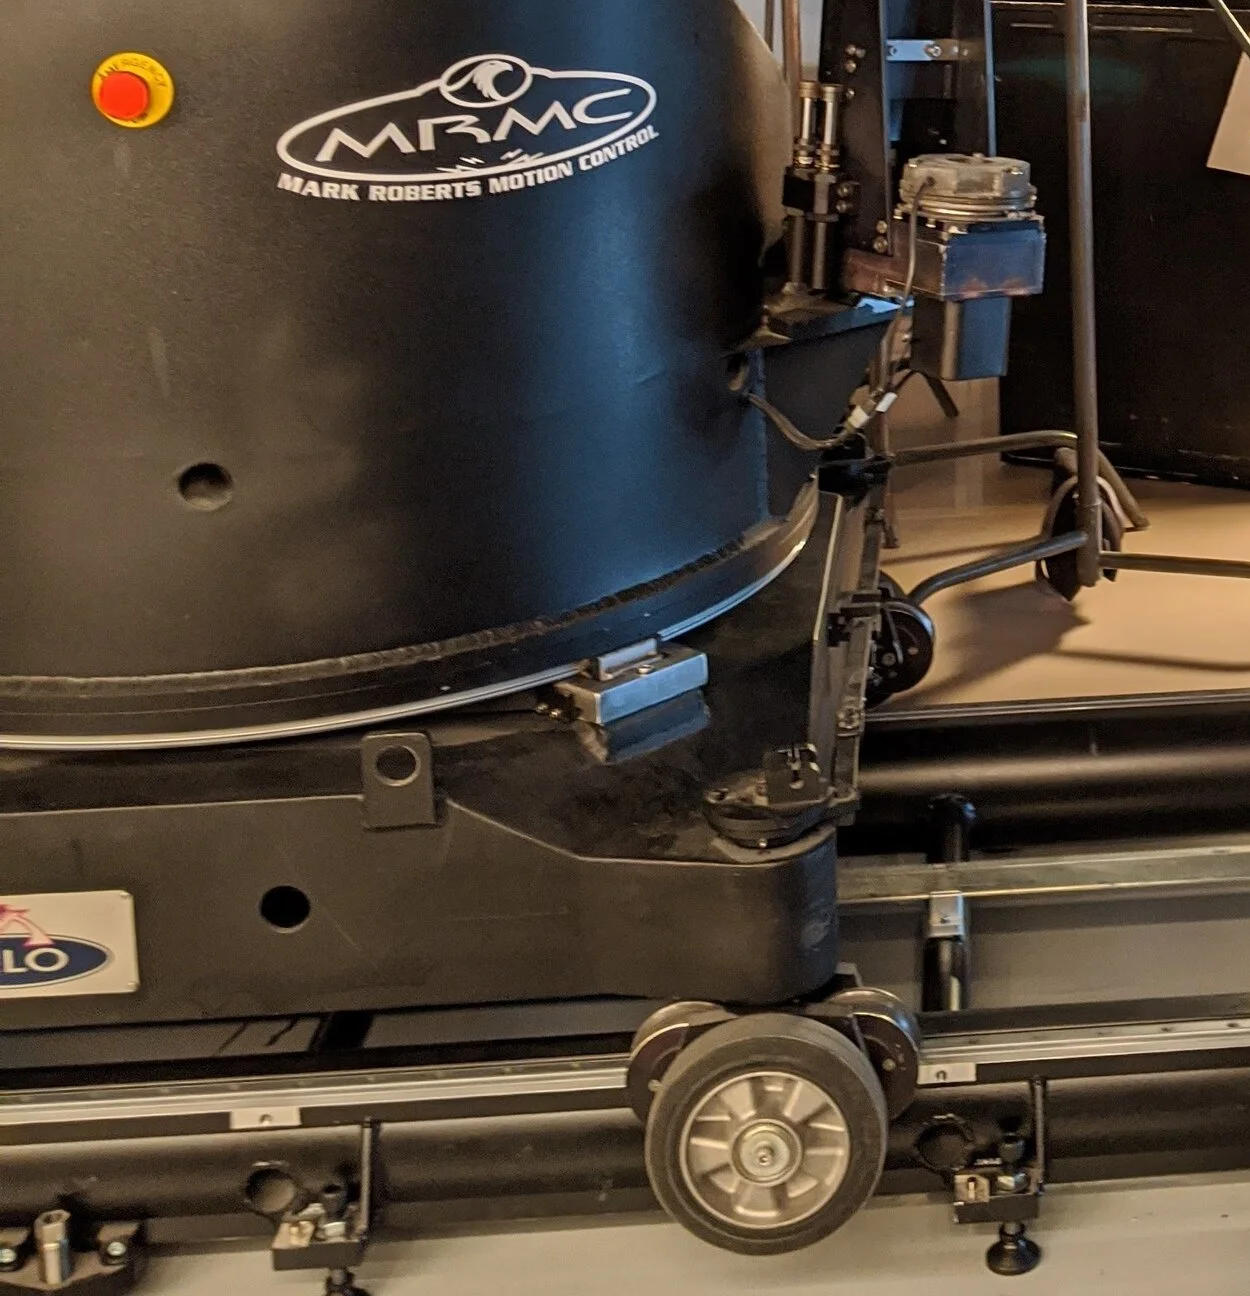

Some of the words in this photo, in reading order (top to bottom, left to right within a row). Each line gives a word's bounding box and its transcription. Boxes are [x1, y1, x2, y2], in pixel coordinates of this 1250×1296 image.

[277, 173, 360, 201] MARK
[369, 179, 482, 202] ROBERTS
[489, 161, 574, 195] MOTION
[579, 124, 661, 172] CONTROL
[0, 947, 70, 973] LO
